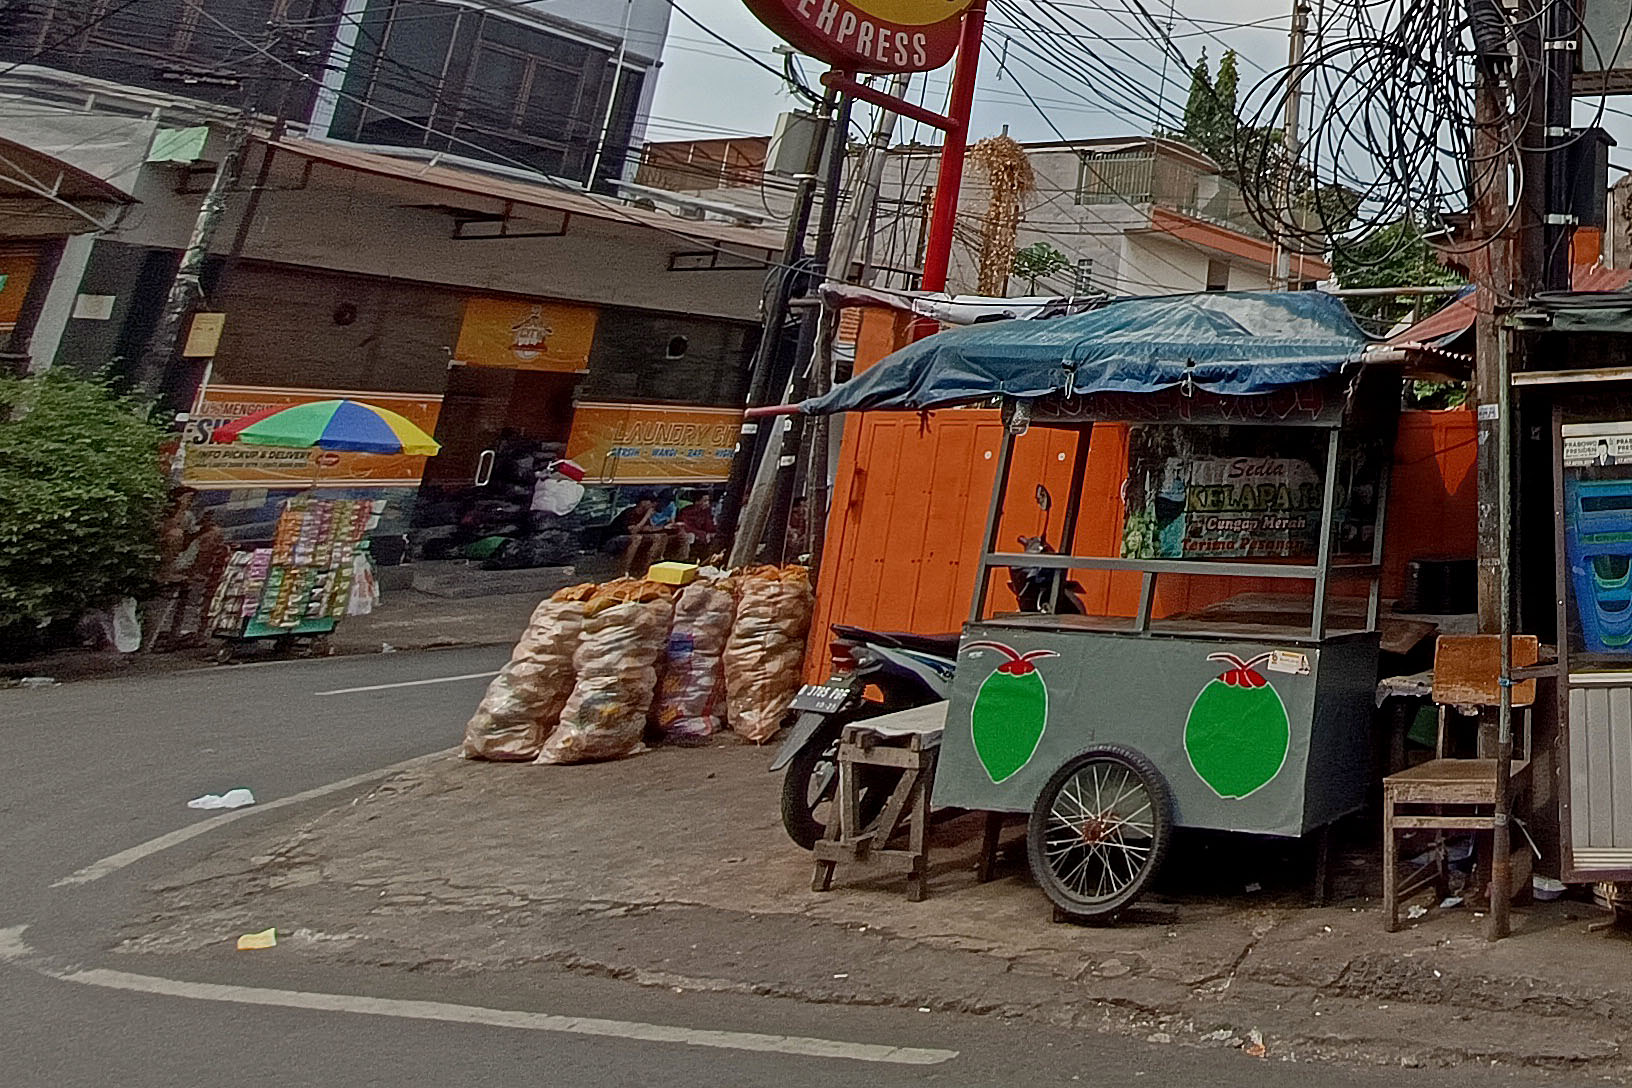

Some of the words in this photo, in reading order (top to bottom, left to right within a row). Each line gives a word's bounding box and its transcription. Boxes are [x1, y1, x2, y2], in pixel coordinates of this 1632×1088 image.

[612, 421, 711, 446] LAUNDRY
[711, 423, 741, 447] CIT
[222, 450, 259, 459] PICKUP
[268, 450, 312, 460] DELIVERY
[1228, 458, 1284, 479] Sedia
[1186, 483, 1293, 512] KELAPA
[1262, 515, 1306, 530] Merah
[1182, 538, 1235, 552] Terima
